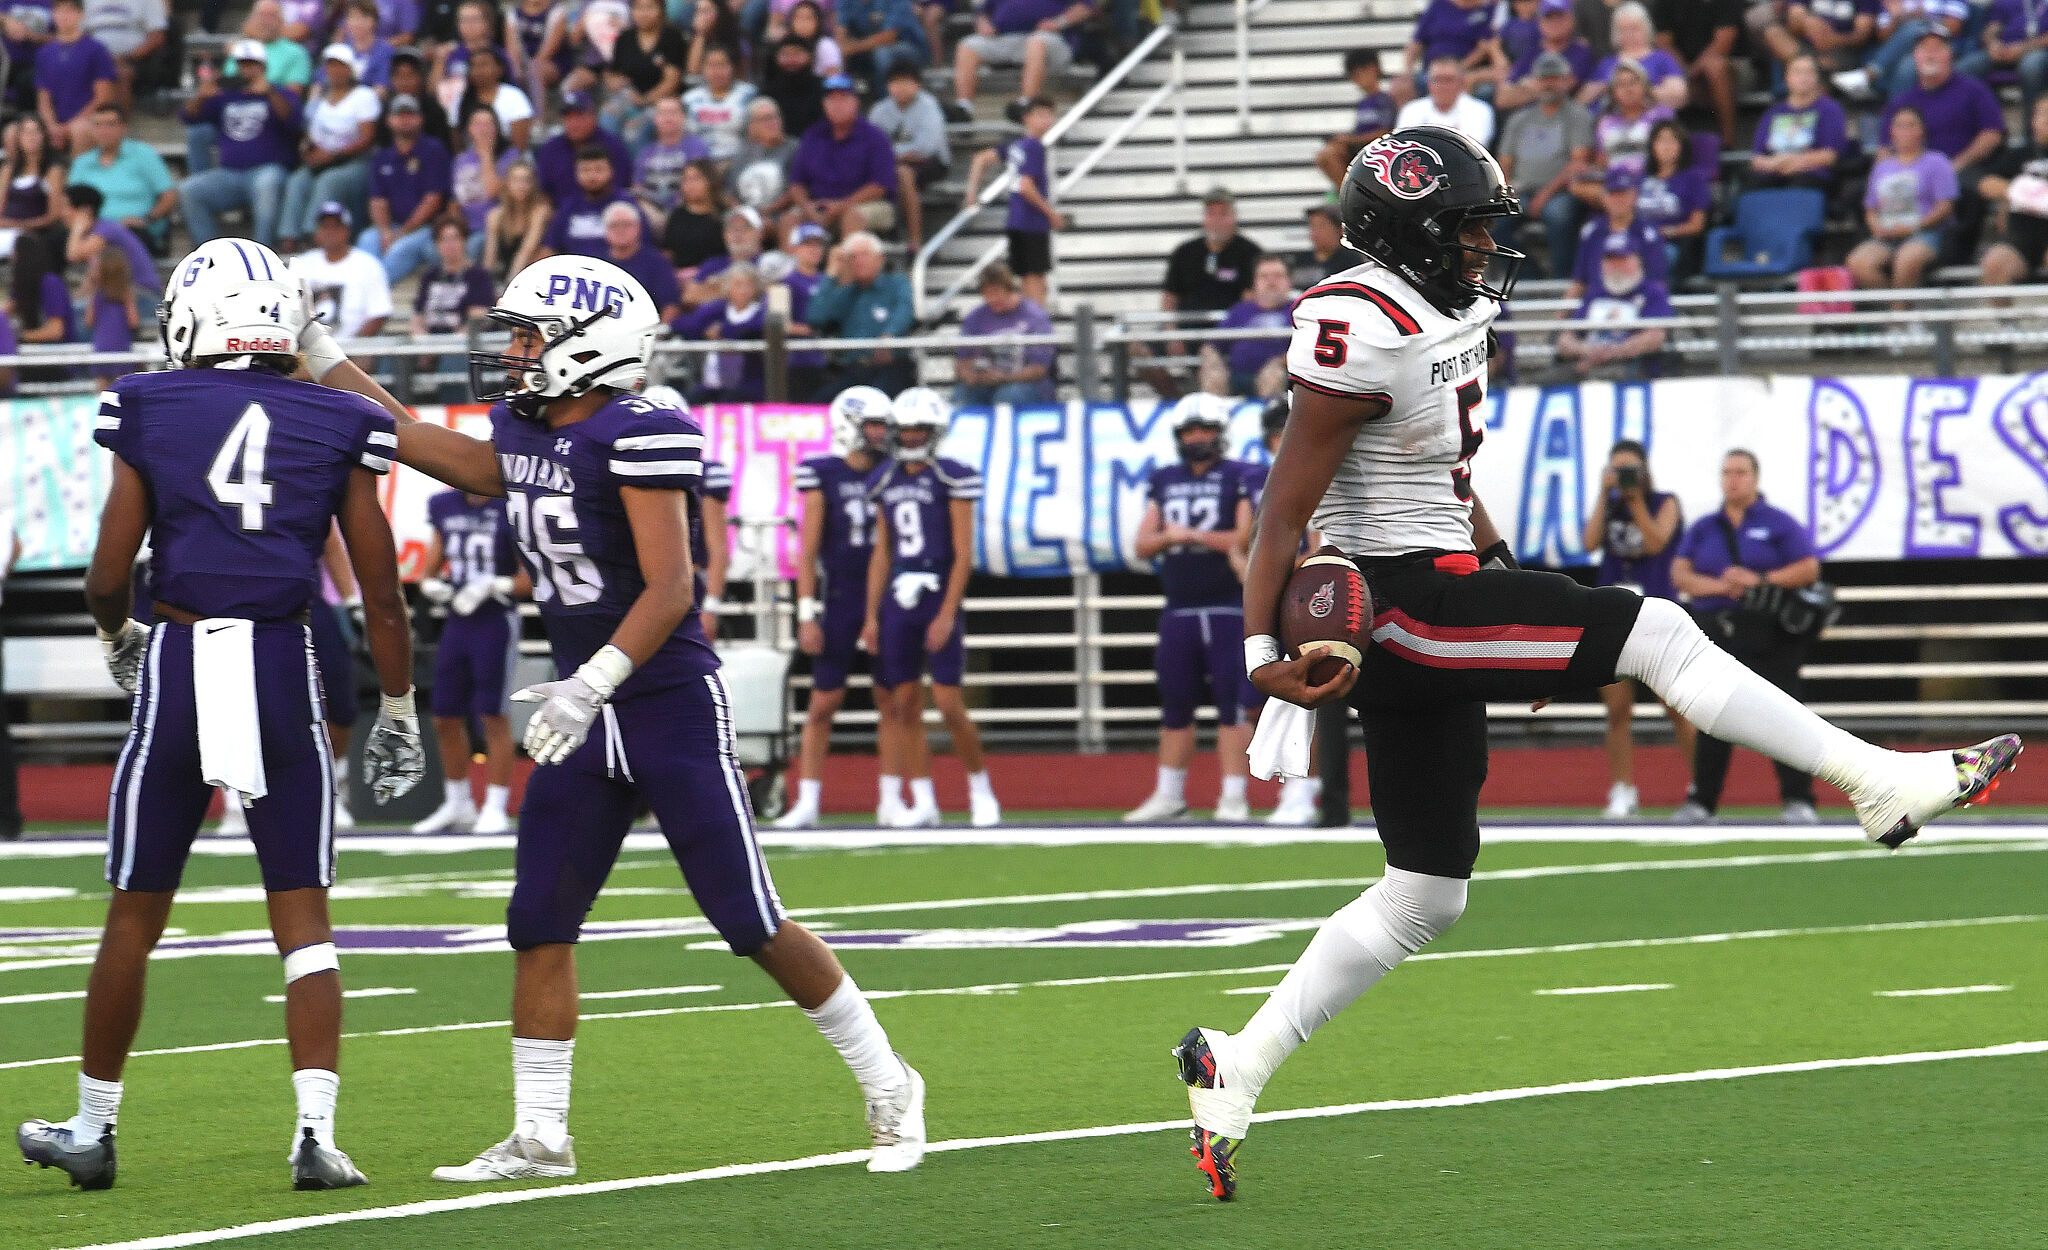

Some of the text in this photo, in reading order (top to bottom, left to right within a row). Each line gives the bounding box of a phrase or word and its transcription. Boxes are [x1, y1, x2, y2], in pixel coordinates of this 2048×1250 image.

[268, 301, 281, 323] 4
[543, 273, 625, 319] PNG
[226, 337, 291, 352] Riddell
[1314, 318, 1350, 368] 5
[1431, 356, 1459, 385] PORT
[1450, 377, 1484, 503] 5
[206, 400, 277, 534] 4
[495, 453, 576, 494] NDIANS
[504, 486, 605, 607] 36
[843, 499, 878, 548] 1
[893, 500, 925, 558] 9
[446, 532, 497, 585] 10
